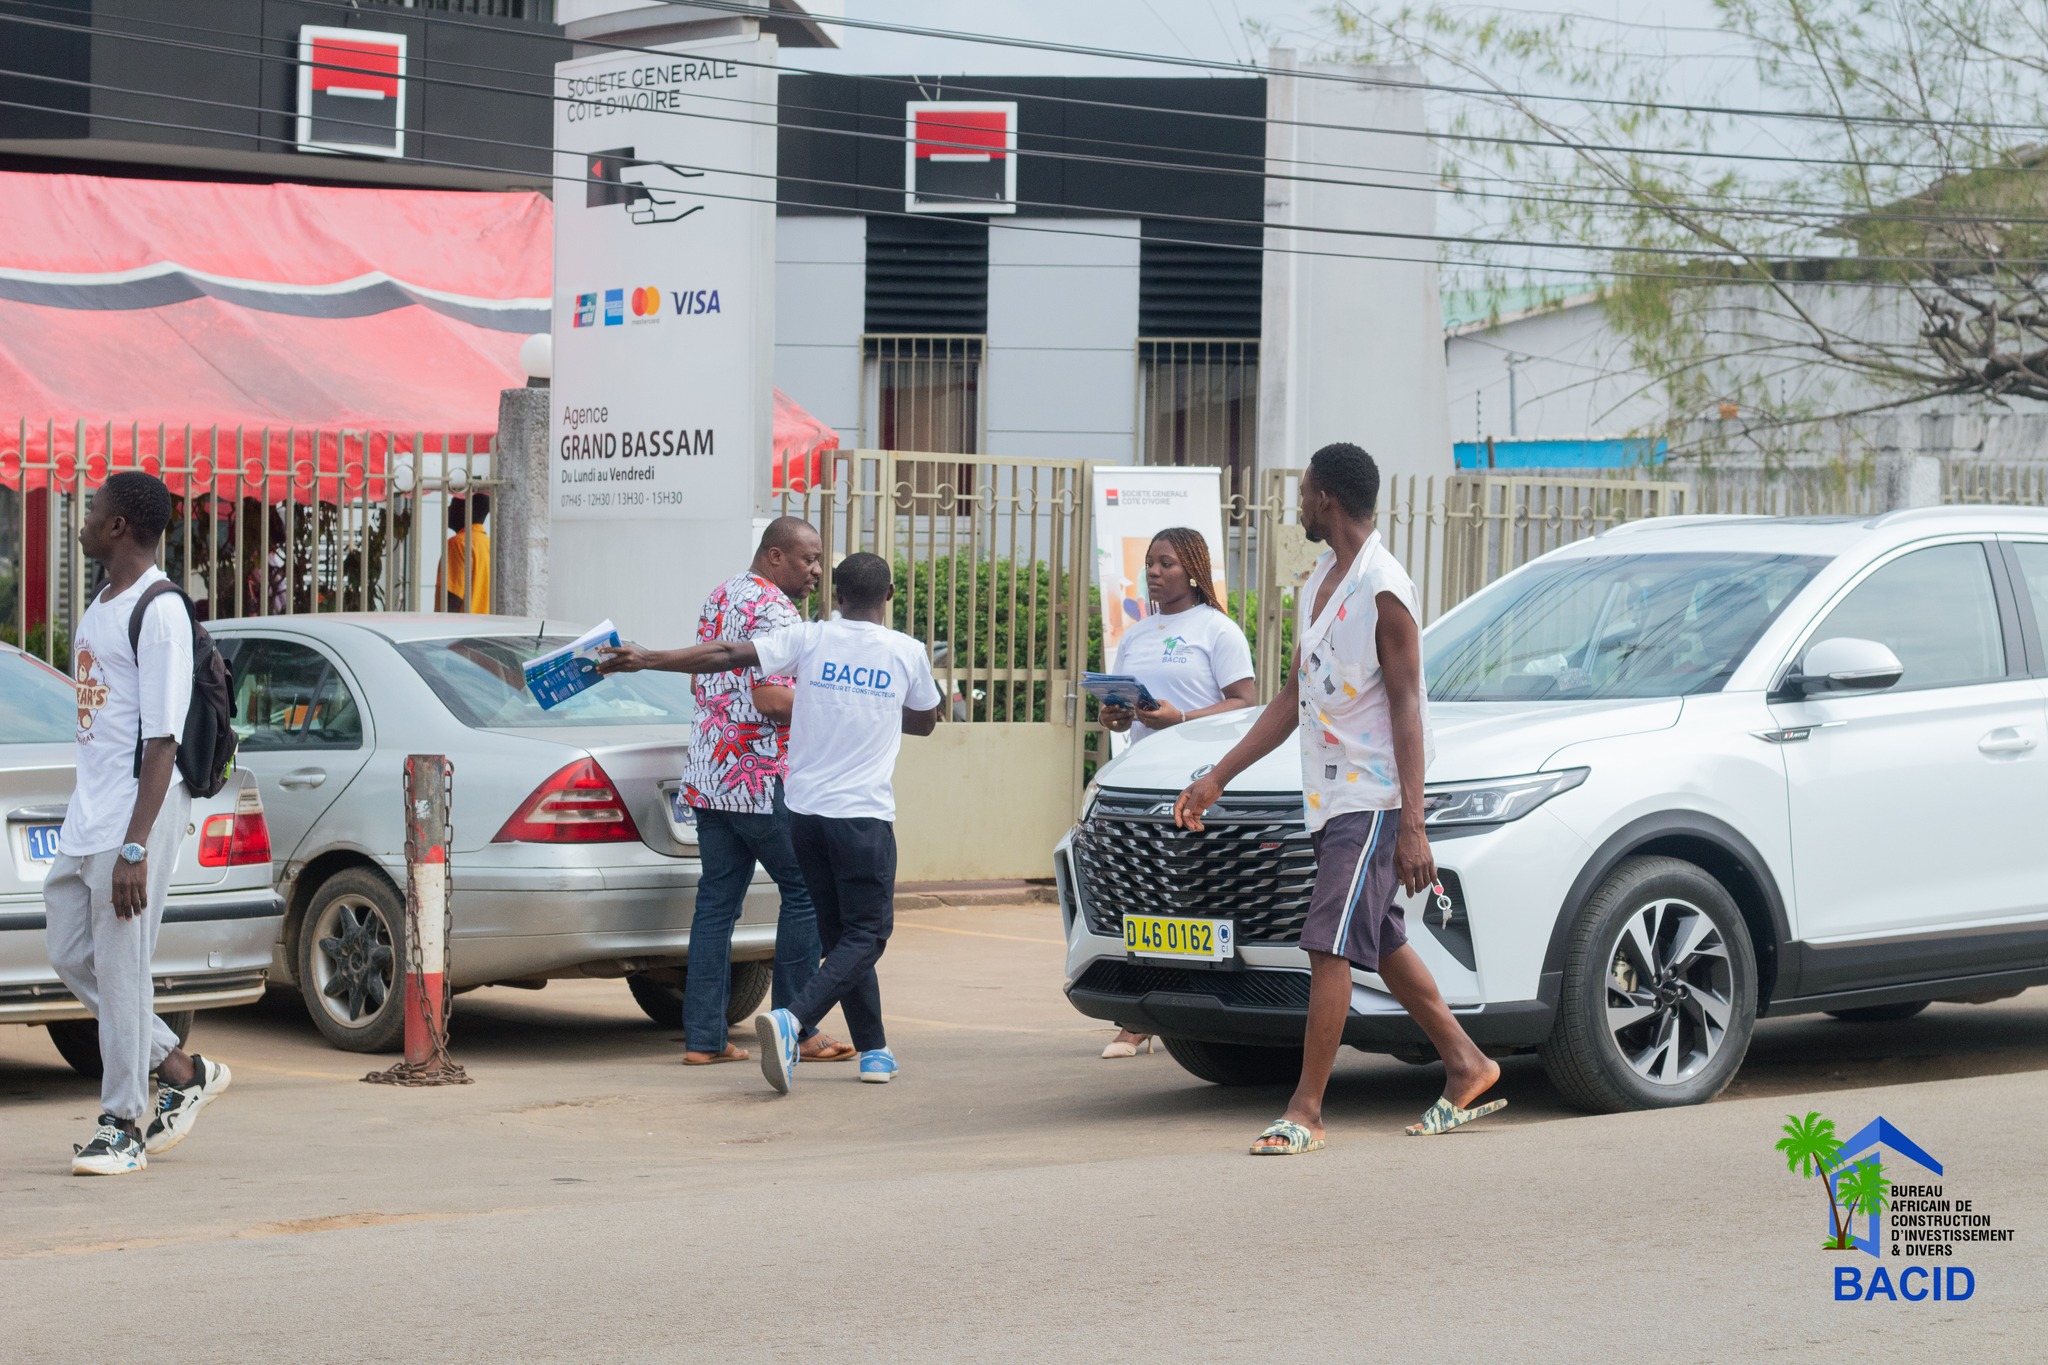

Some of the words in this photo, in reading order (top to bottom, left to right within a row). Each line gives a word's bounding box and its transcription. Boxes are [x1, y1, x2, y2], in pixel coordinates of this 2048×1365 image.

[568, 71, 626, 99] SOCIETE
[632, 59, 738, 88] GENERALE
[607, 89, 680, 115] D'IVOIRE
[670, 290, 720, 315] VISA
[563, 406, 608, 430] Agence
[561, 433, 617, 461] GRAND
[622, 429, 714, 458] BASSAM
[561, 469, 573, 484] Du
[574, 467, 596, 483] Lundi
[597, 471, 608, 482] au
[610, 465, 655, 481] Vendredi
[588, 493, 610, 506] 12H30
[618, 491, 644, 505] 13H30
[652, 491, 683, 504] 15H30
[1152, 490, 1189, 498] GENERALE
[1162, 656, 1187, 664] BACID
[822, 662, 891, 689] BACID
[809, 680, 844, 692] PROMOTEUR
[852, 687, 896, 698] CONSTRUCTEUR
